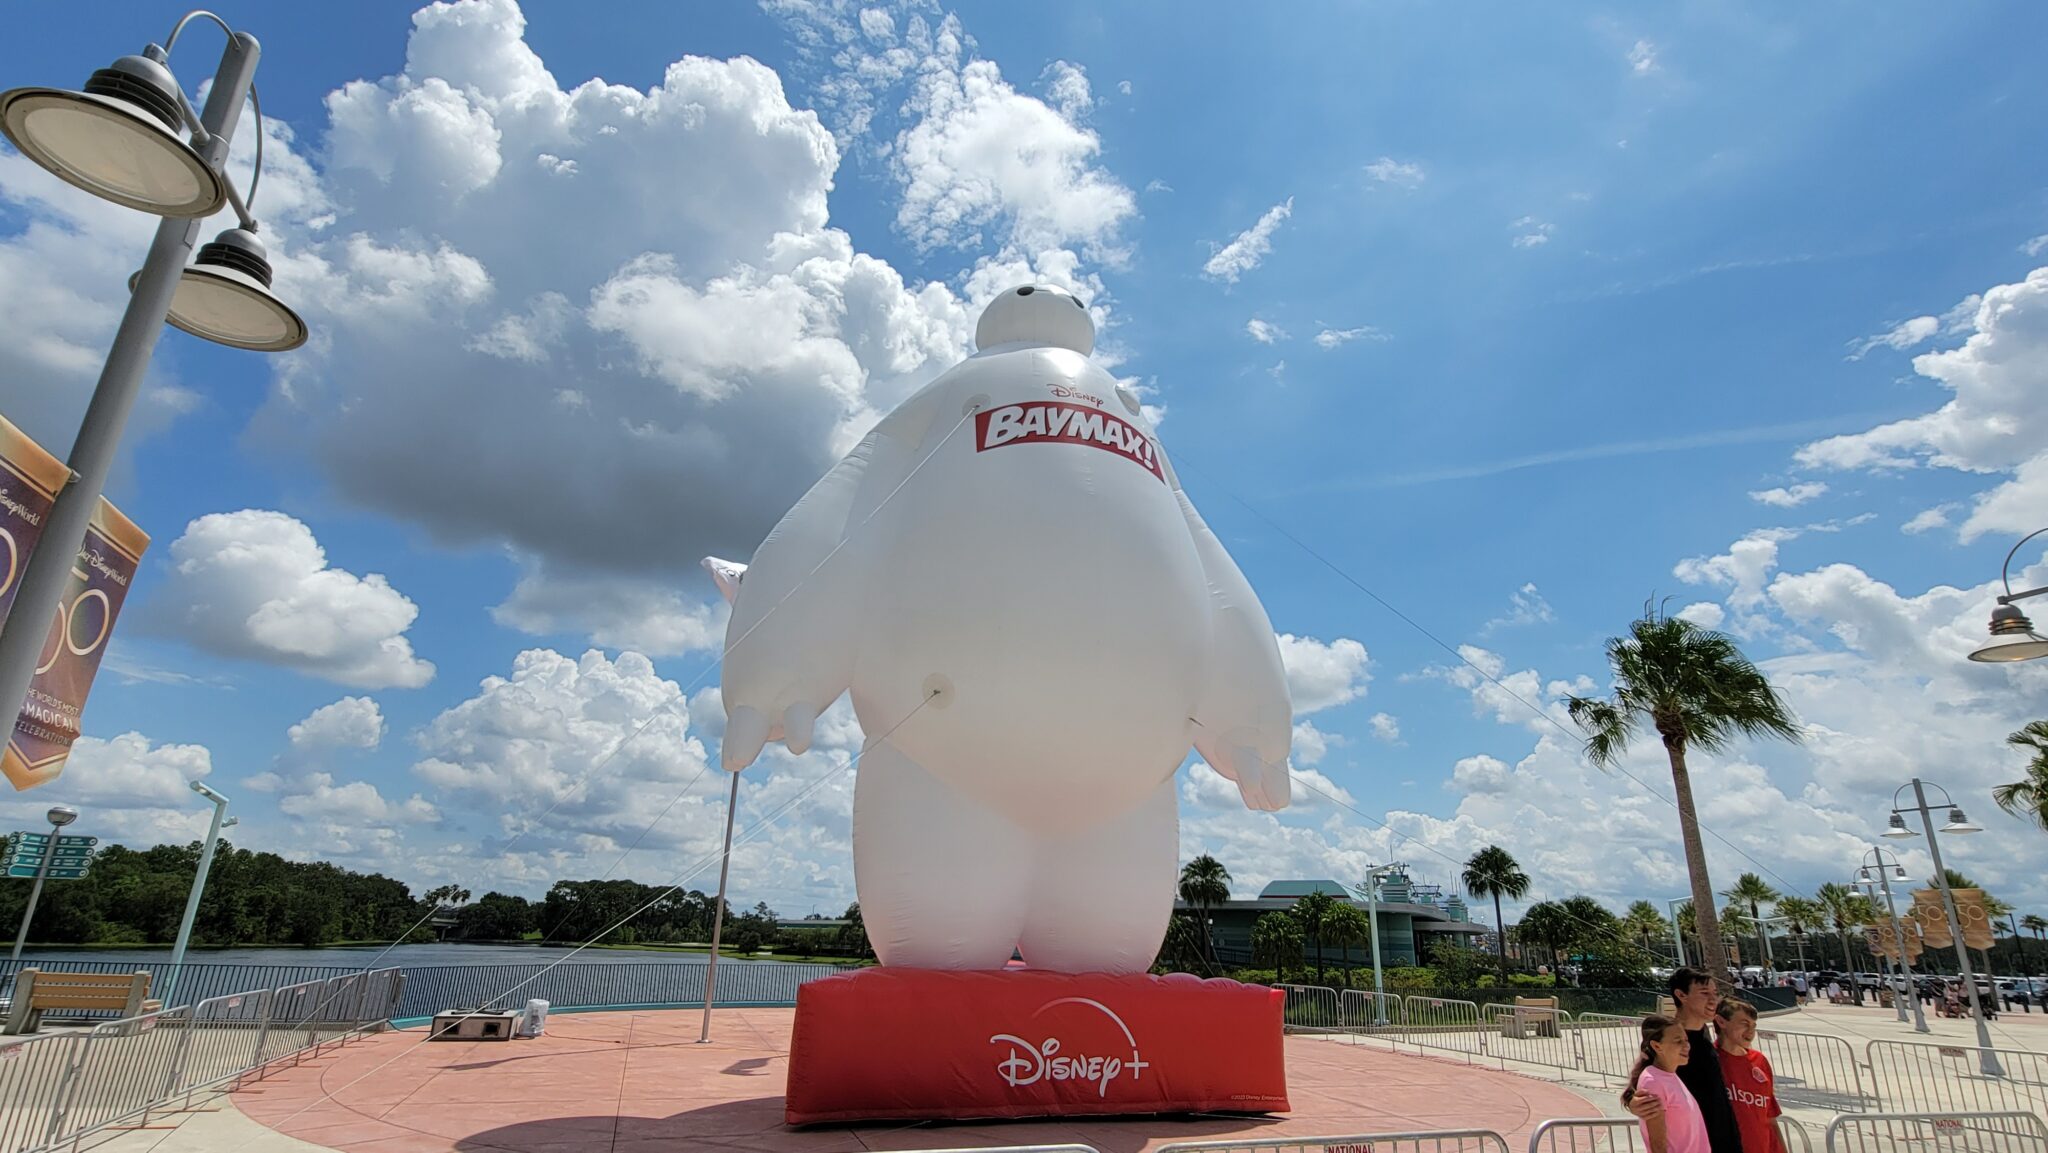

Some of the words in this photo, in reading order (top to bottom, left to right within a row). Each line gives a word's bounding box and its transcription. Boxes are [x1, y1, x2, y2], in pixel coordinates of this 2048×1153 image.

[1047, 384, 1104, 408] Disney
[984, 405, 1154, 470] BAYMAX!
[25, 701, 74, 733] MAGICAL
